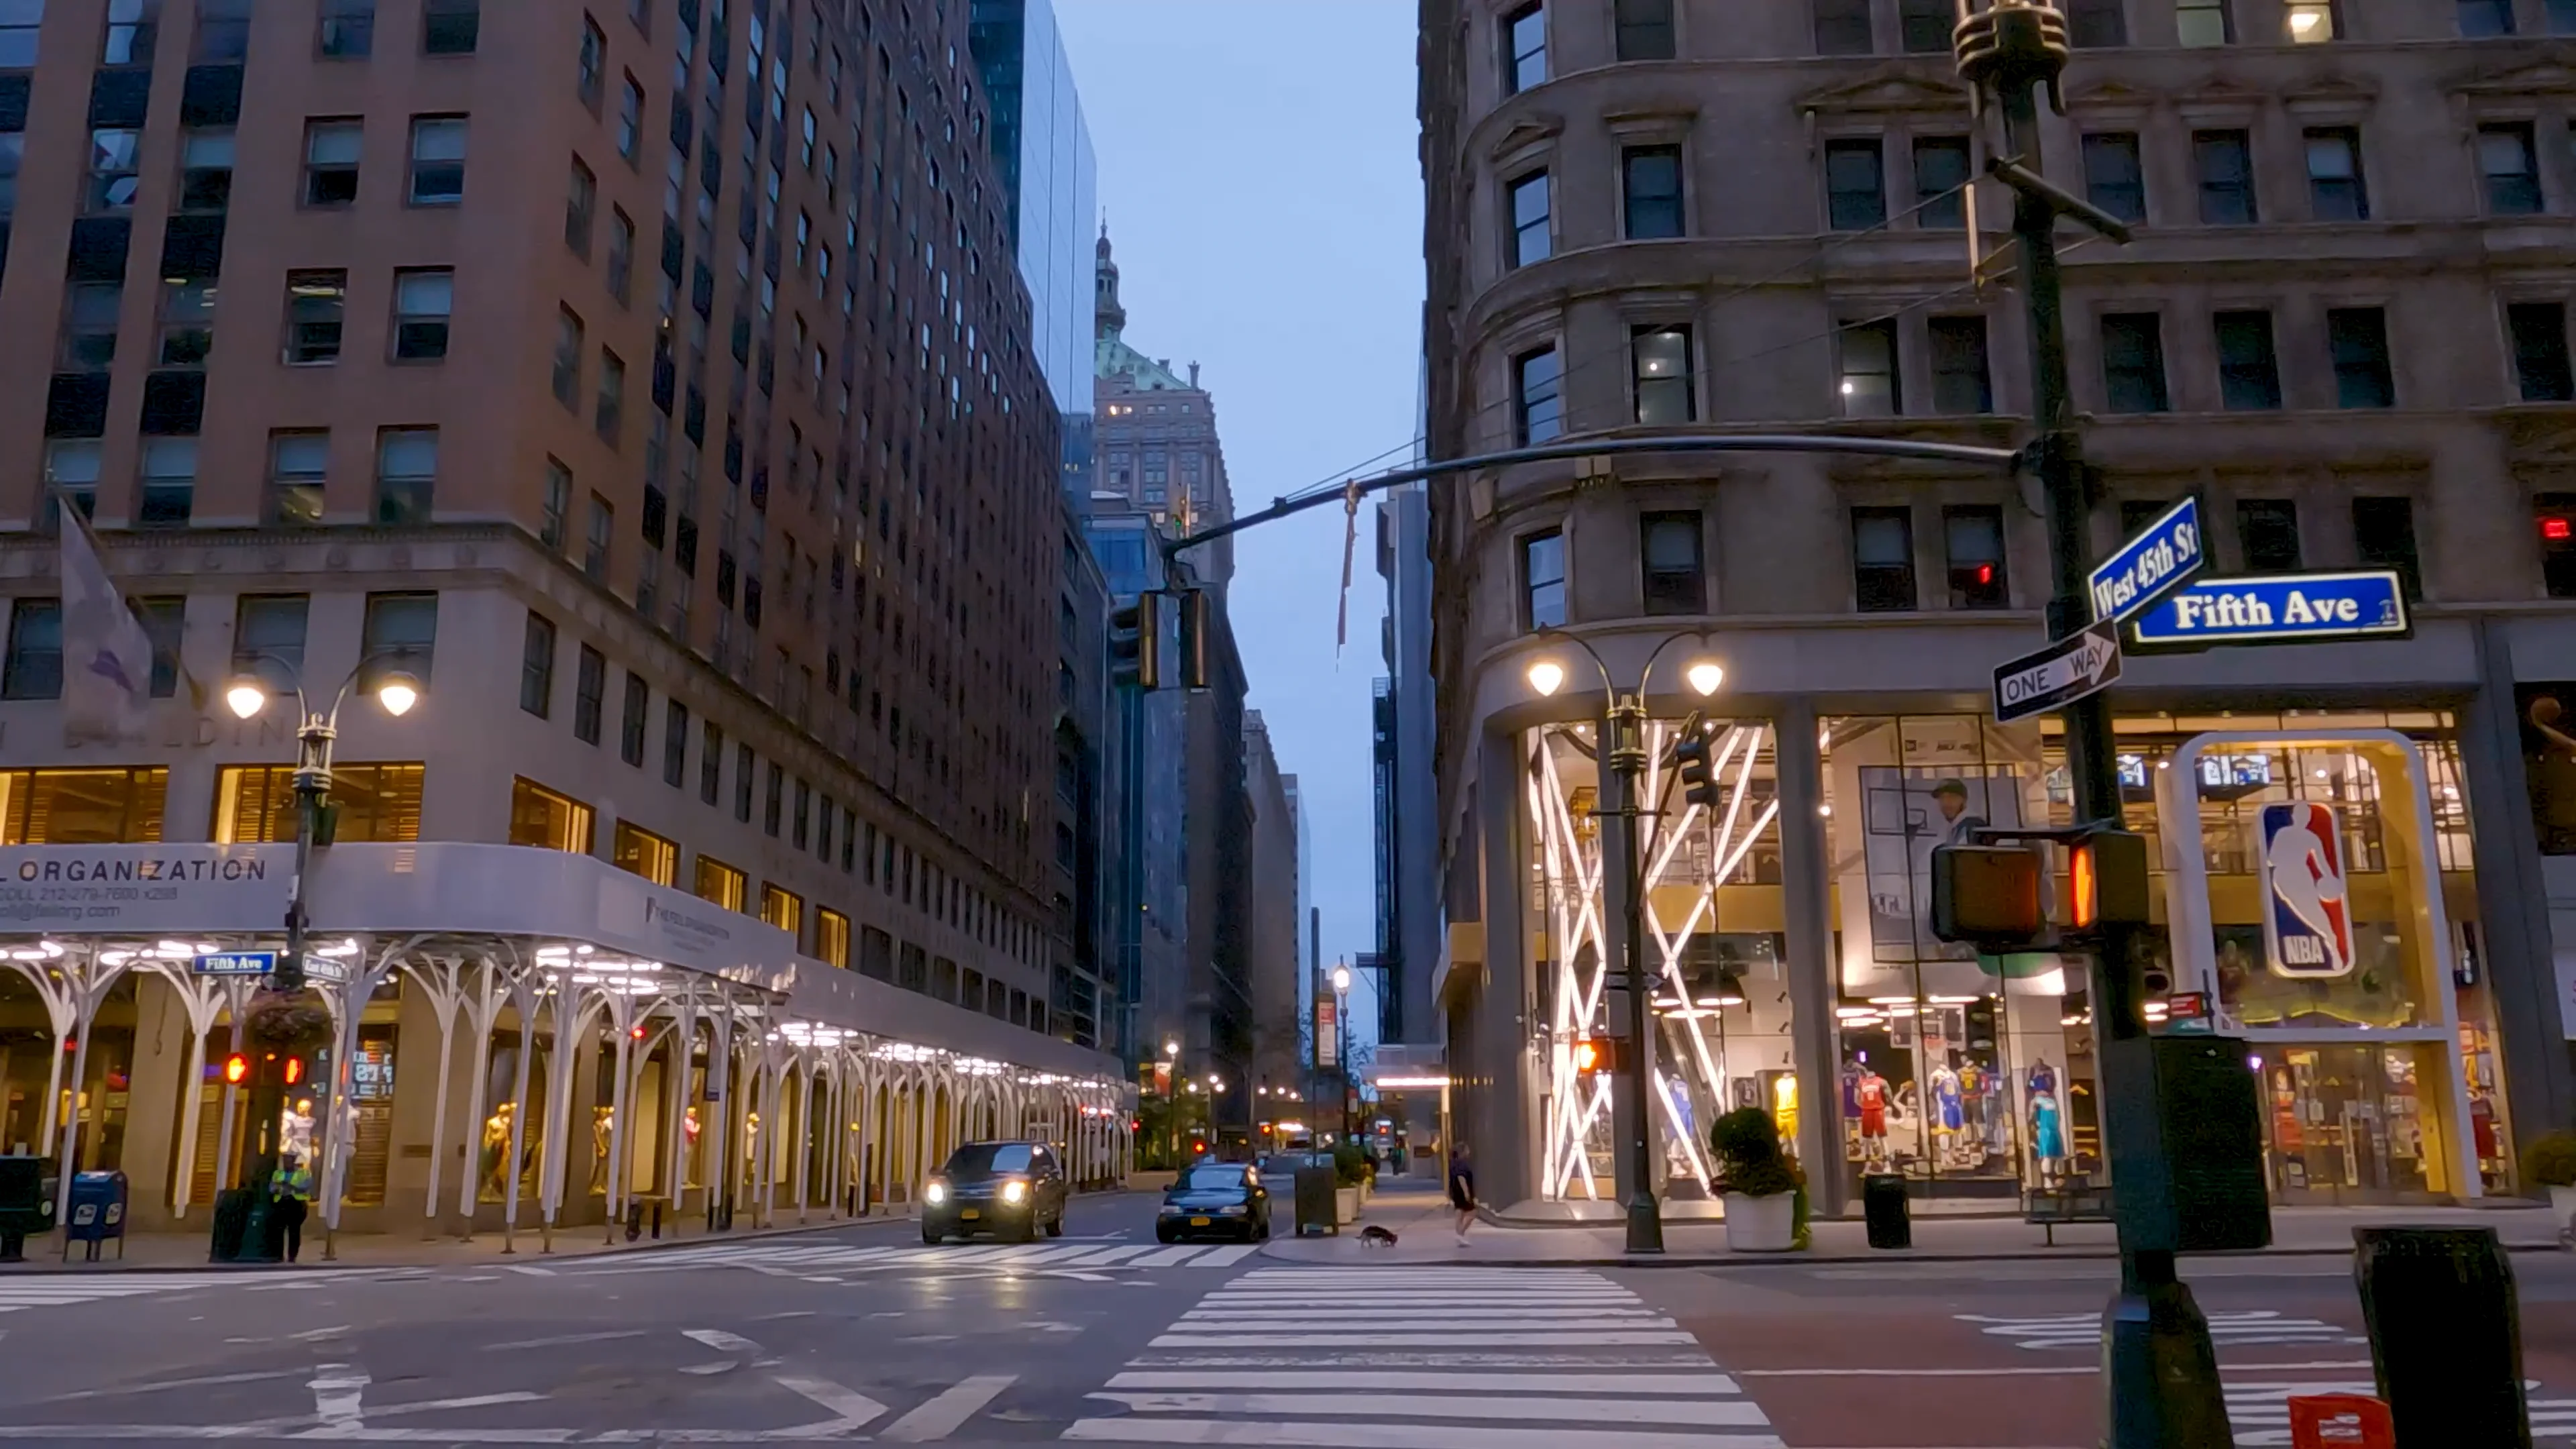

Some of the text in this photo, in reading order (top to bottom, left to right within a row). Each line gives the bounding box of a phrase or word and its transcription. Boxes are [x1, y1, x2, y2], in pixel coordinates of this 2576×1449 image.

[2095, 523, 2198, 617] West 45th St
[2173, 590, 2360, 629] Fifth Ave
[2006, 641, 2104, 701] ONE WAY
[19, 859, 266, 882] ORGANIZATION
[205, 957, 264, 970] Fifth Ave
[2282, 934, 2326, 964] NBA
